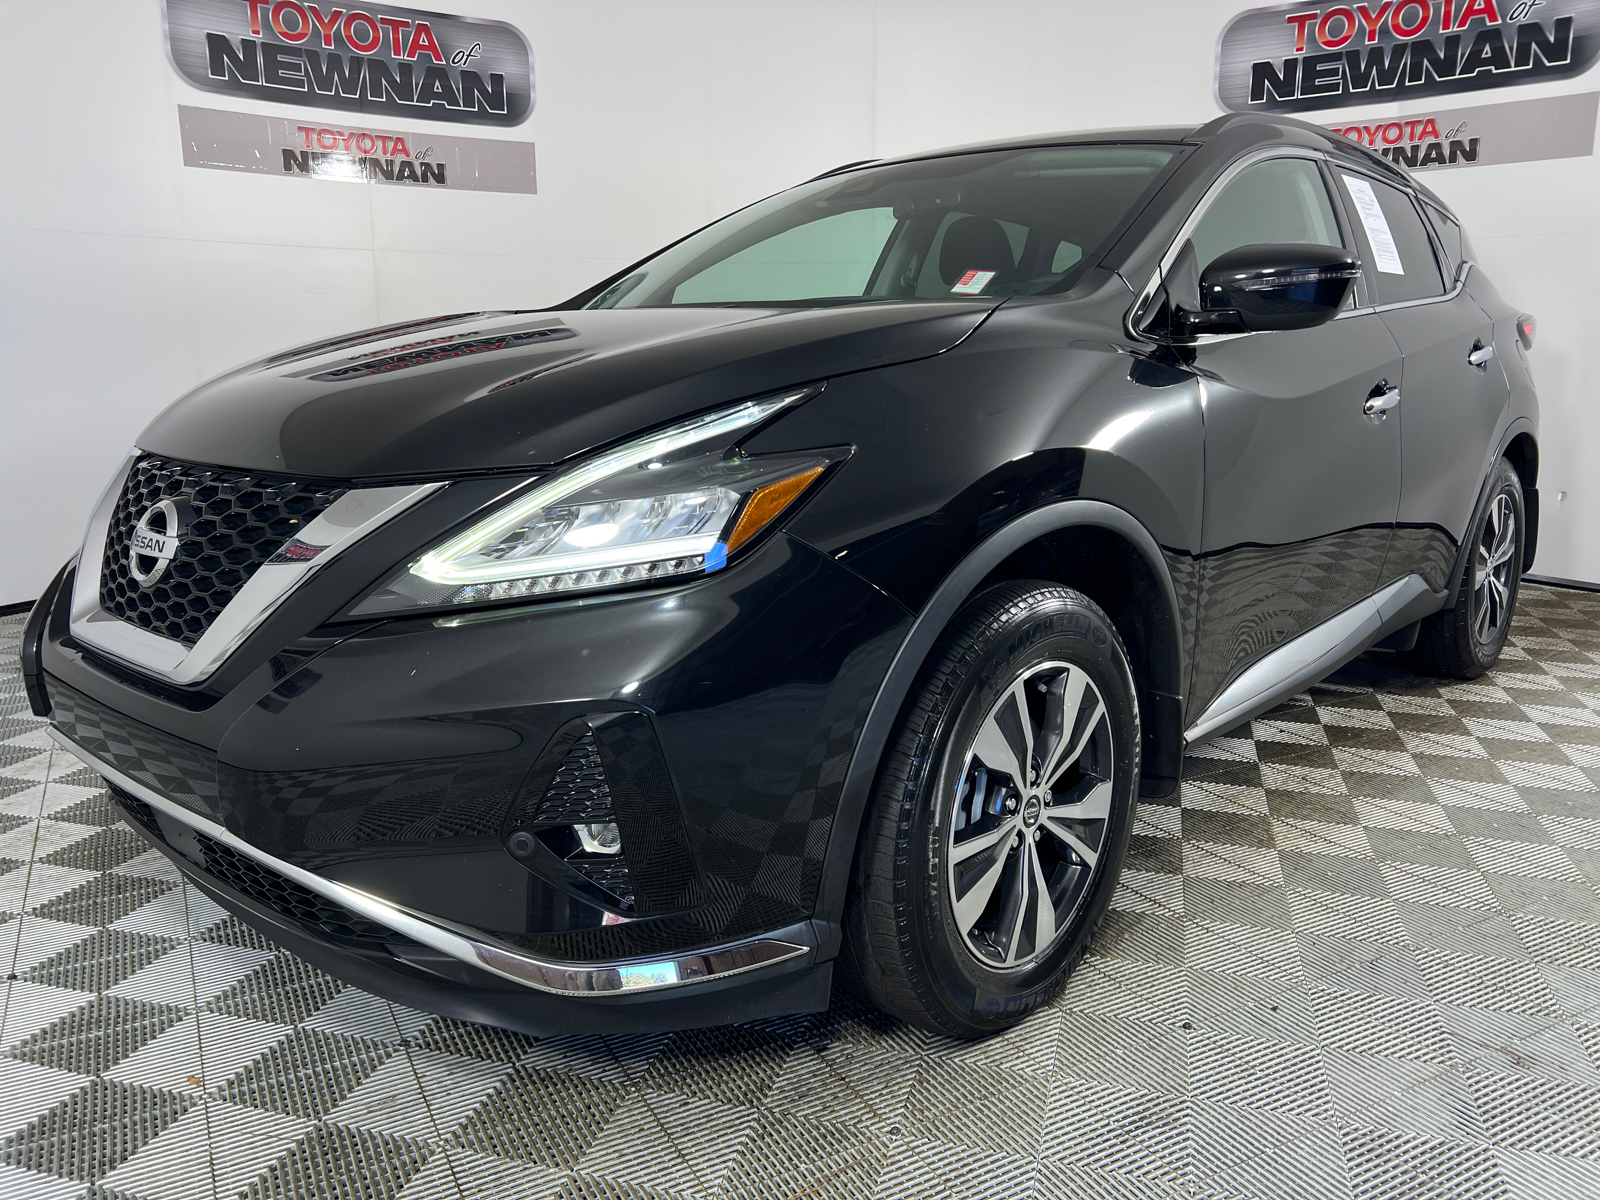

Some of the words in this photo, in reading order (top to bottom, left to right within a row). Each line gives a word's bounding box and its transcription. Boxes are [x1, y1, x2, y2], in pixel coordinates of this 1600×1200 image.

[247, 0, 445, 64] TOYOTA
[450, 43, 481, 66] of
[1286, 0, 1501, 53] TOYOTA
[1507, 0, 1546, 22] of
[205, 31, 507, 114] NEWNAN
[1248, 15, 1575, 104] NEWNAN
[297, 125, 411, 158] TOYOTA
[414, 146, 434, 160] of
[1445, 121, 1468, 139] of
[281, 148, 447, 185] NNAN
[1371, 137, 1480, 169] NAN
[132, 533, 166, 553] SSAN
